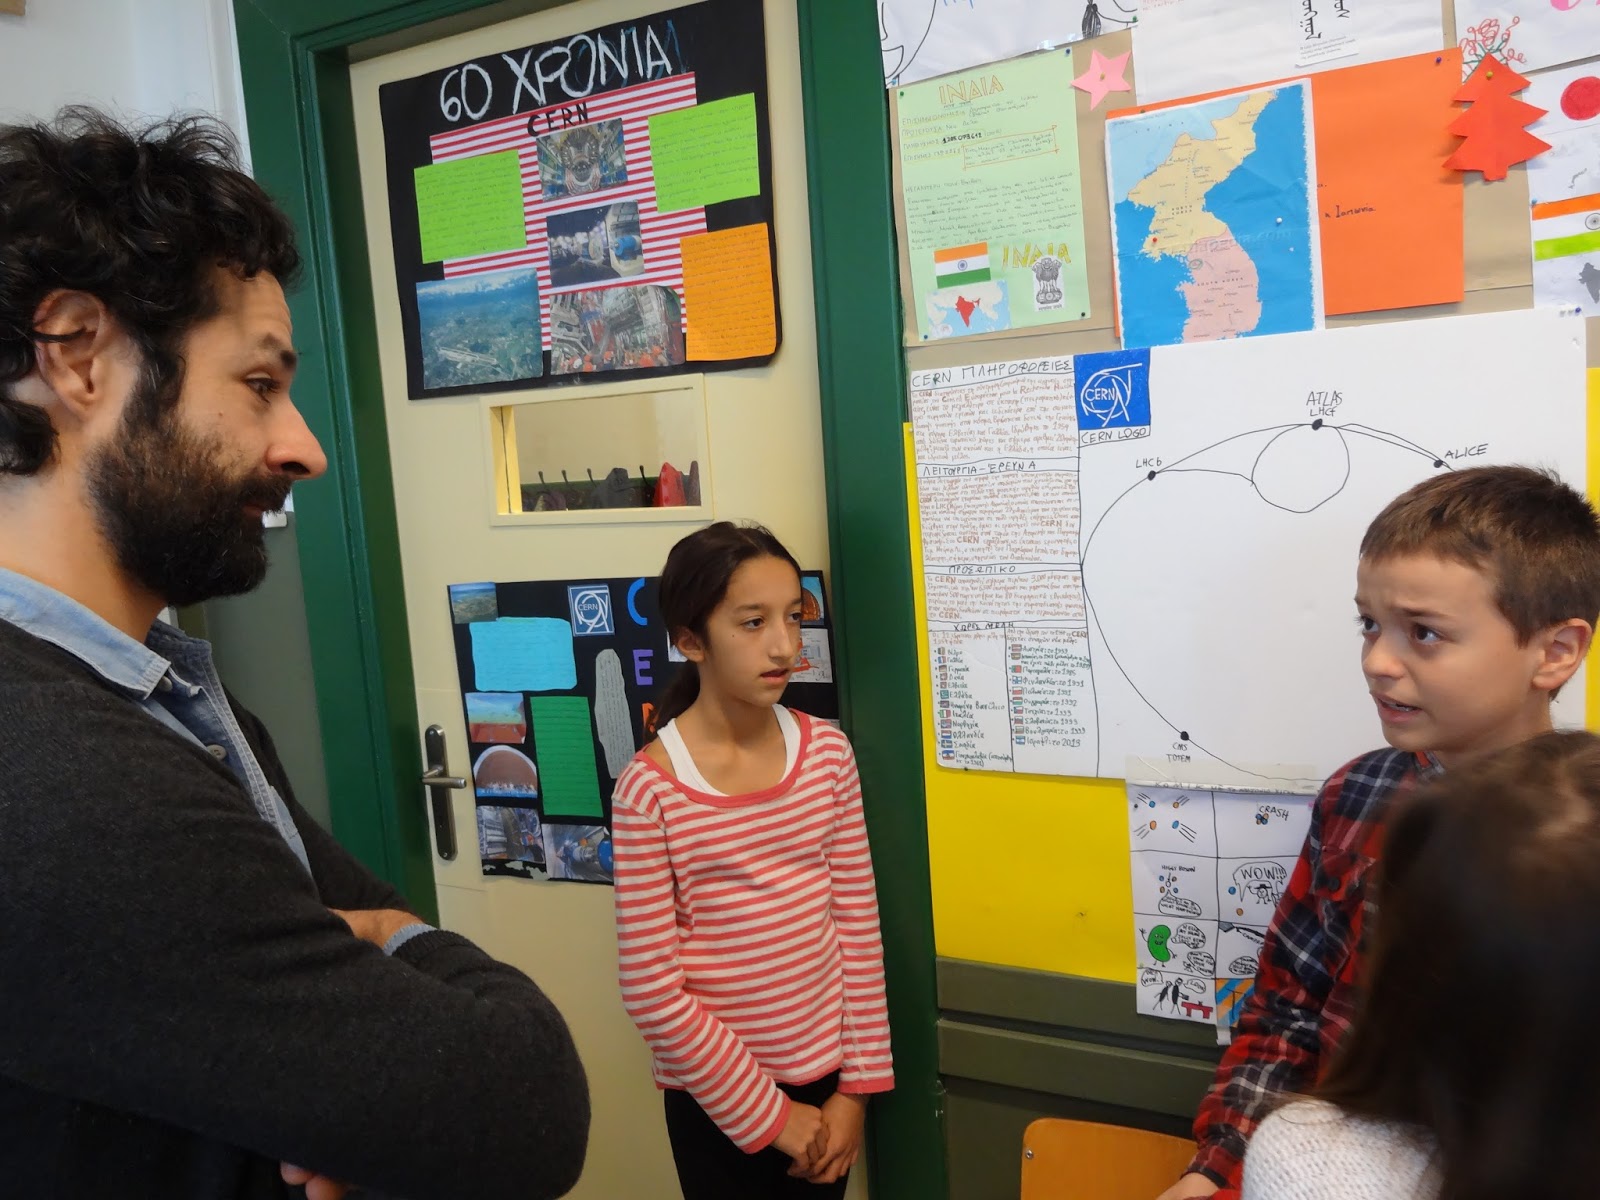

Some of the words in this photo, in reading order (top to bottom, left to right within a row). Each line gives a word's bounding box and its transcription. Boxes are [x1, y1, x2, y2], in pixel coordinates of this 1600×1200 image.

[439, 63, 492, 122] 60
[501, 24, 674, 114] ΧΡΟΝΙΑ
[526, 102, 590, 137] CERN
[912, 370, 951, 388] CERN
[1085, 388, 1116, 402] CERN
[1306, 391, 1343, 407] ATLAS
[1081, 431, 1113, 444] CERN
[1116, 428, 1148, 439] LOGO
[1444, 443, 1489, 459] ALICE
[577, 602, 599, 612] CERN
[1172, 742, 1188, 751] CMS
[1166, 753, 1191, 763] TOTEM
[1258, 805, 1289, 821] CRASH
